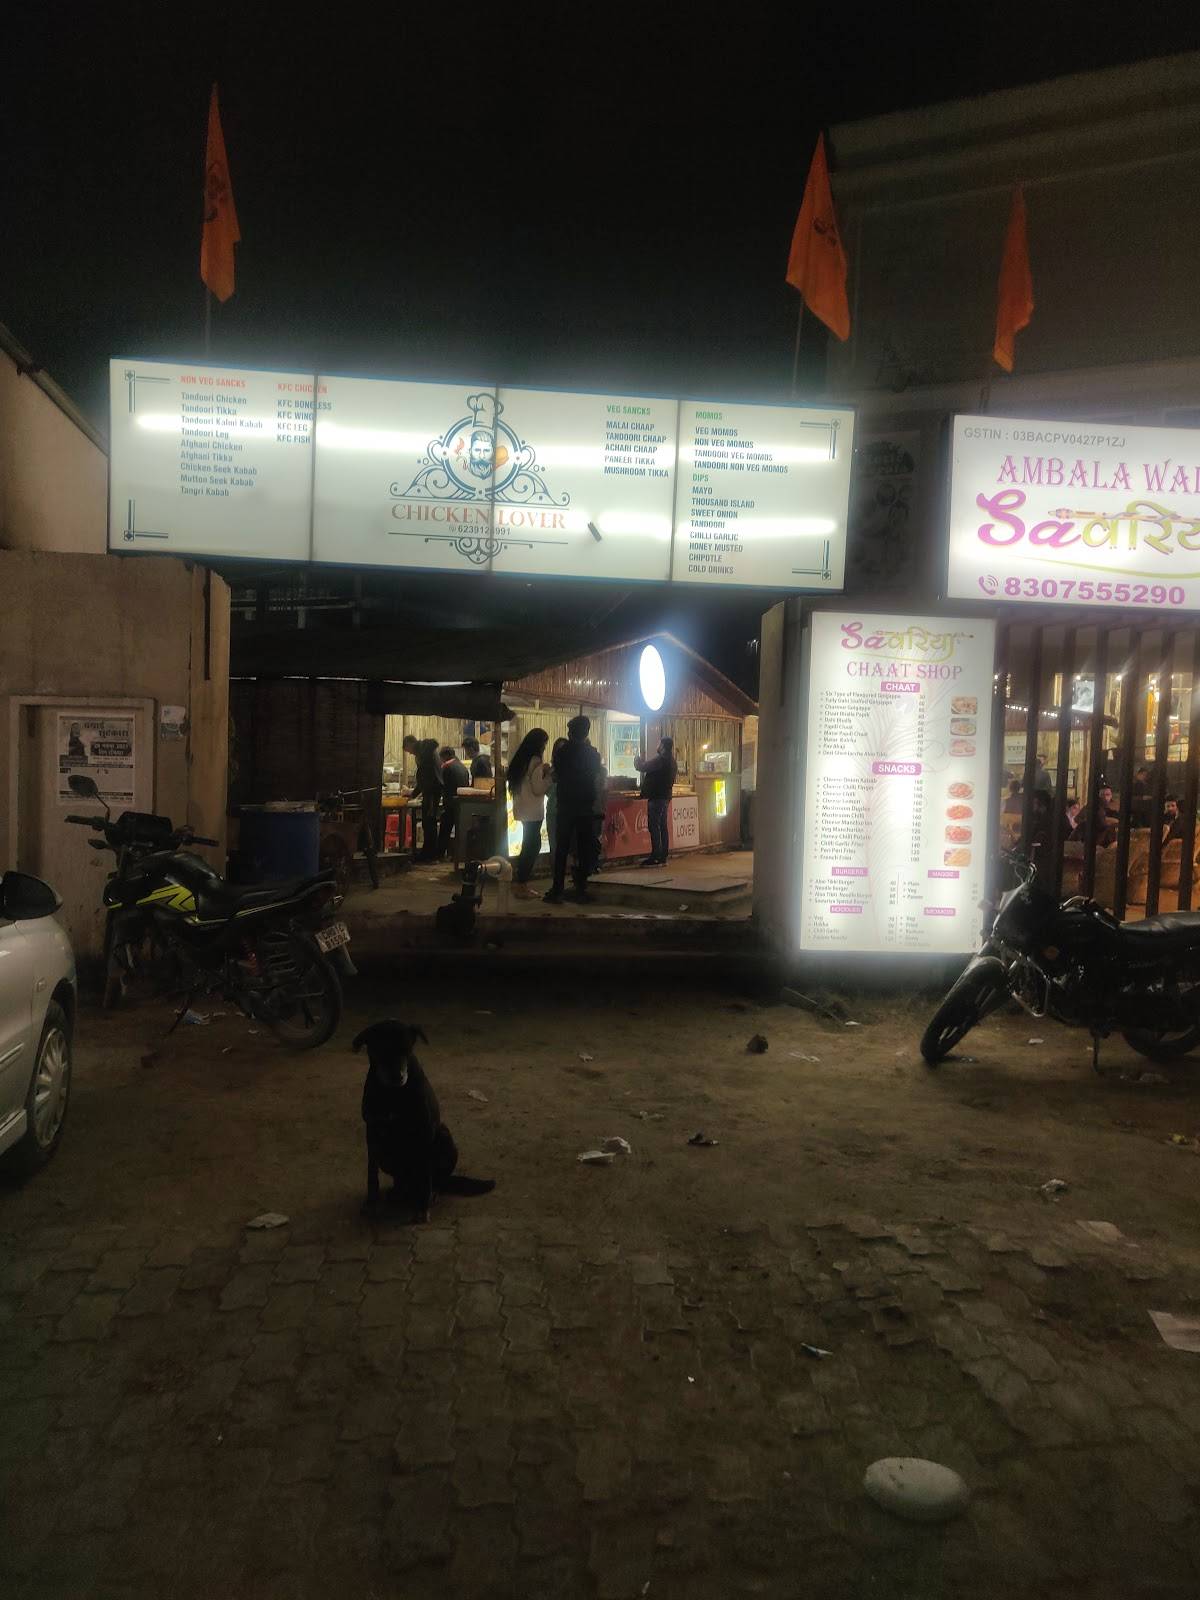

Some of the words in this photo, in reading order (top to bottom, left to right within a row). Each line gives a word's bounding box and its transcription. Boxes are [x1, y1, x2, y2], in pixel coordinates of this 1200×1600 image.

[181, 376, 196, 384] NON
[199, 376, 213, 385] VEG
[216, 378, 246, 387] SANCKS
[277, 384, 292, 392] KFC
[295, 384, 328, 393] CHICEN
[181, 392, 213, 402] Tandoori
[216, 394, 247, 404] Chicken
[182, 404, 213, 413] Tandoori
[217, 406, 237, 415] Tikka
[277, 400, 292, 408] KFC
[295, 400, 332, 410] BONEESS
[277, 411, 292, 419] KFC
[607, 405, 620, 413] VEG
[623, 406, 651, 416] SANCKS
[696, 411, 722, 420] MOMOS
[181, 416, 213, 425] Tandoori
[216, 418, 237, 427] Kalmi
[240, 420, 263, 428] Kabab
[277, 422, 291, 430] KFC
[294, 424, 308, 432] LEG
[607, 421, 628, 430] MALAI
[631, 422, 655, 431] CHAAP
[182, 428, 213, 437] Tandoori
[216, 430, 229, 439] Leg
[696, 426, 709, 435] VEG
[711, 428, 738, 436] MOMOS
[277, 434, 292, 442] KFC
[294, 435, 311, 443] FISH
[606, 432, 640, 441] TANDOORI
[643, 434, 666, 443] CHAAP
[964, 427, 1001, 440] GSTIN
[1013, 430, 1126, 448] 03BACPV0427P1ZJ
[181, 440, 210, 449] Afghani
[213, 441, 242, 451] Chicken
[695, 438, 709, 446] NON
[711, 439, 725, 447] VEG
[727, 440, 754, 448] MOMOS
[605, 444, 631, 452] ACHARI
[634, 445, 657, 453] CHAAP
[181, 451, 210, 460] Afghani
[213, 453, 232, 462] Tikka
[695, 450, 728, 458] TANDOORI
[747, 453, 773, 461] MOMOS
[635, 457, 656, 465] TIKKA
[181, 463, 211, 472] Chicken
[234, 467, 257, 475] Kabab
[604, 466, 646, 476] MUSHROOM
[648, 469, 668, 477] TIKKA
[694, 460, 728, 470] TANDOORI
[731, 463, 744, 471] NON
[747, 464, 760, 472] VEG
[762, 465, 788, 474] MOMOS
[693, 473, 708, 482] DIPS
[996, 455, 1132, 490] AMBALA
[181, 475, 208, 483] Mutton
[231, 478, 254, 486] Kabab
[181, 486, 203, 496] Tangri
[206, 487, 229, 496] Kabab
[692, 498, 728, 507] THOUSAND
[731, 500, 755, 508] ISLAND
[391, 504, 490, 524] CHICKEN
[498, 510, 566, 529] LOVER
[691, 509, 715, 517] SWEET
[717, 510, 738, 518] ONION
[691, 520, 725, 528] TANDOORI
[458, 525, 510, 535] 623912991
[690, 531, 712, 540] CHILLI
[714, 532, 738, 541] GARLIC
[690, 542, 712, 551] HONEY
[715, 544, 743, 552] MUSTED
[689, 553, 722, 563] CHIPOTLE
[689, 564, 706, 573] COLD
[709, 565, 734, 574] DRINKS
[1004, 577, 1186, 605] 8307555290
[847, 661, 911, 678] CHAAT
[917, 664, 962, 680] SHOP
[886, 683, 916, 692] CHAAT
[878, 765, 916, 773] SNACKS
[673, 807, 697, 821] CHICKEN
[676, 825, 696, 838] LOVER
